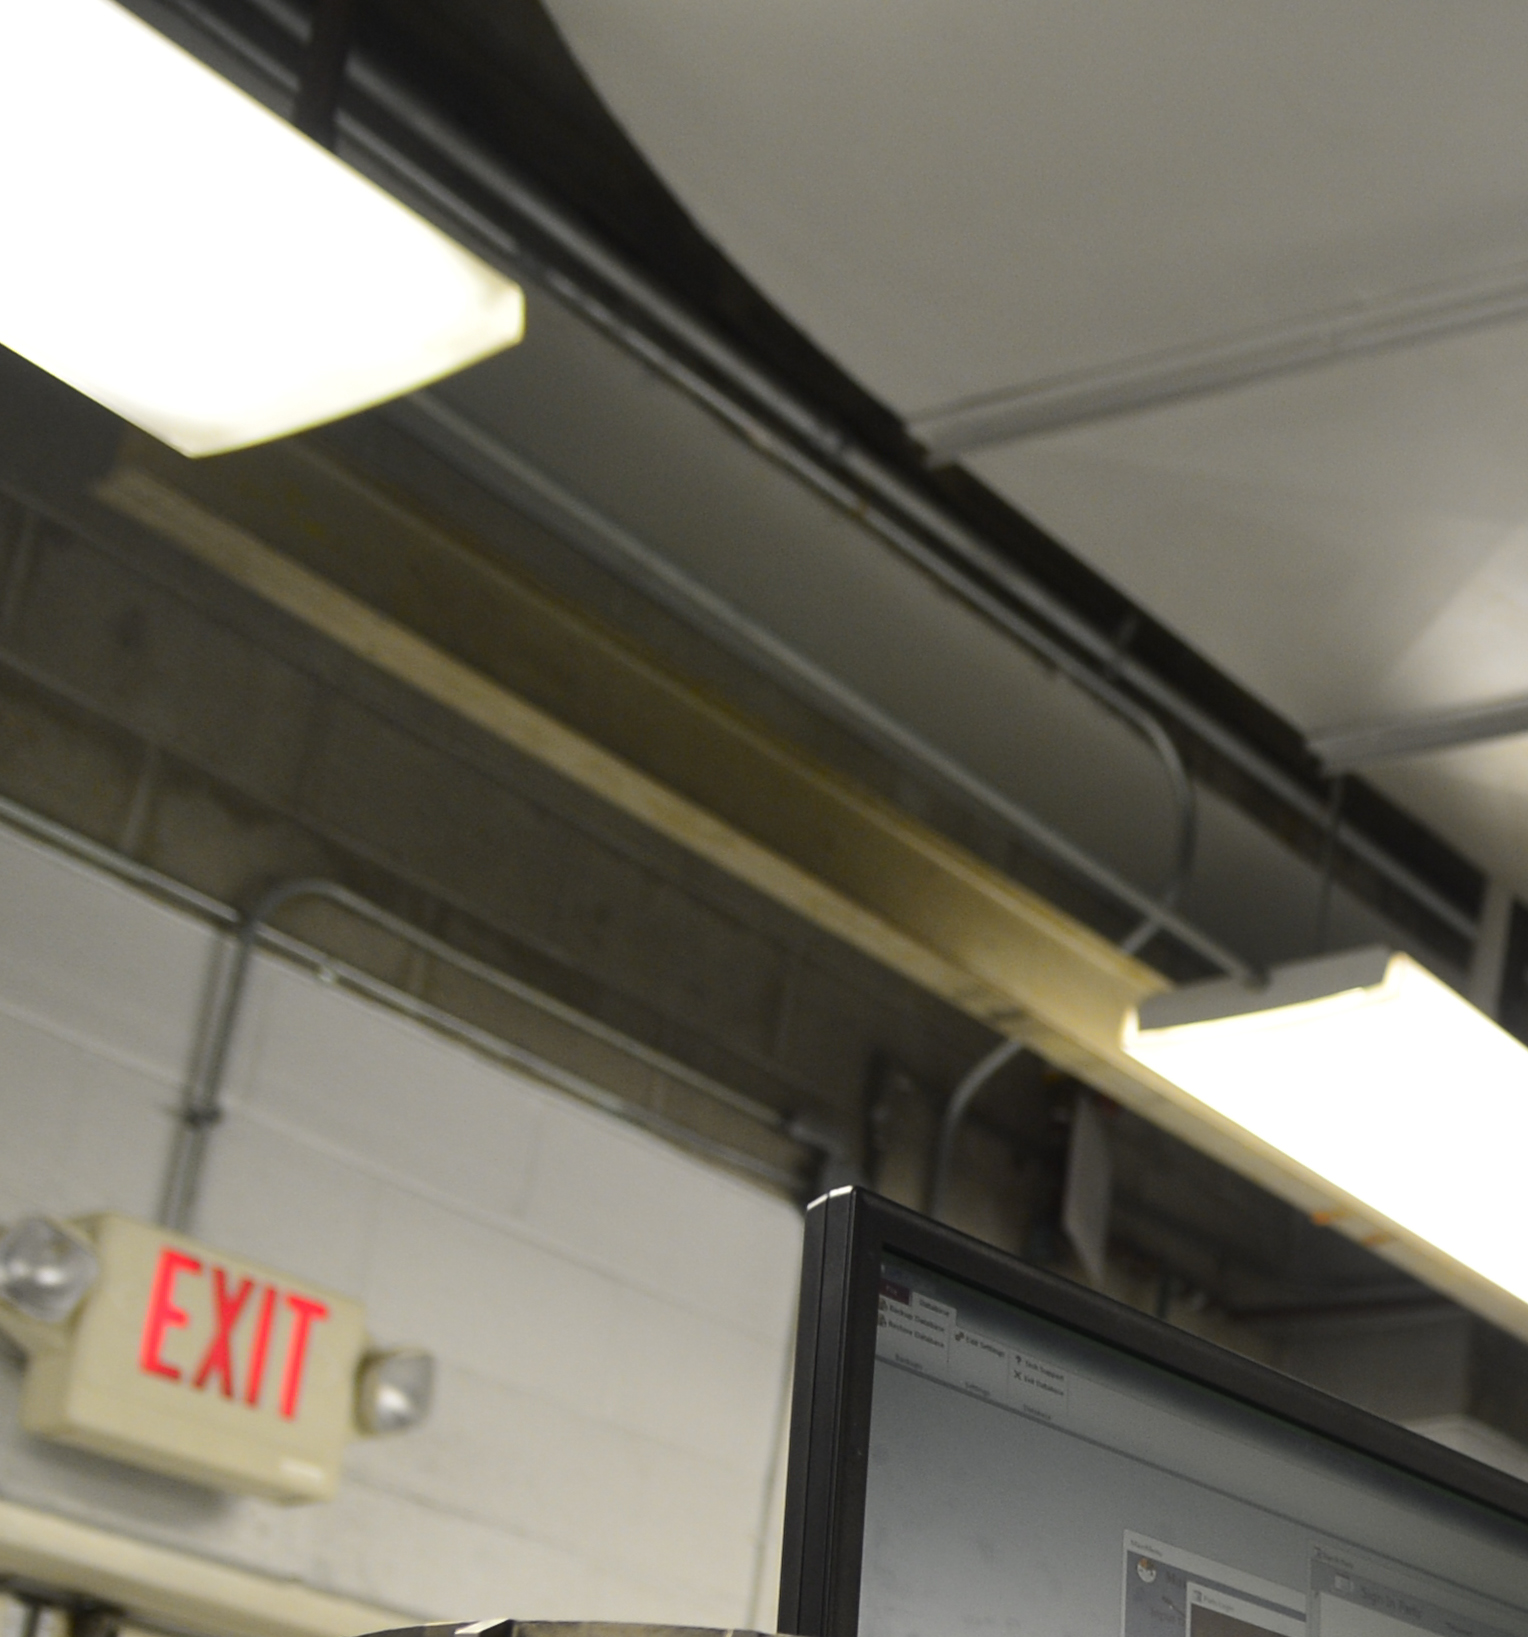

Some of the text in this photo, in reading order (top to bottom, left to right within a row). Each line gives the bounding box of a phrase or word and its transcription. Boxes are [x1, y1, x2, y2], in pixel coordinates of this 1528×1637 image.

[139, 1244, 332, 1421] EXIT
[914, 1315, 946, 1333] Database
[914, 1331, 945, 1348] Database
[979, 1340, 1005, 1358] Settings
